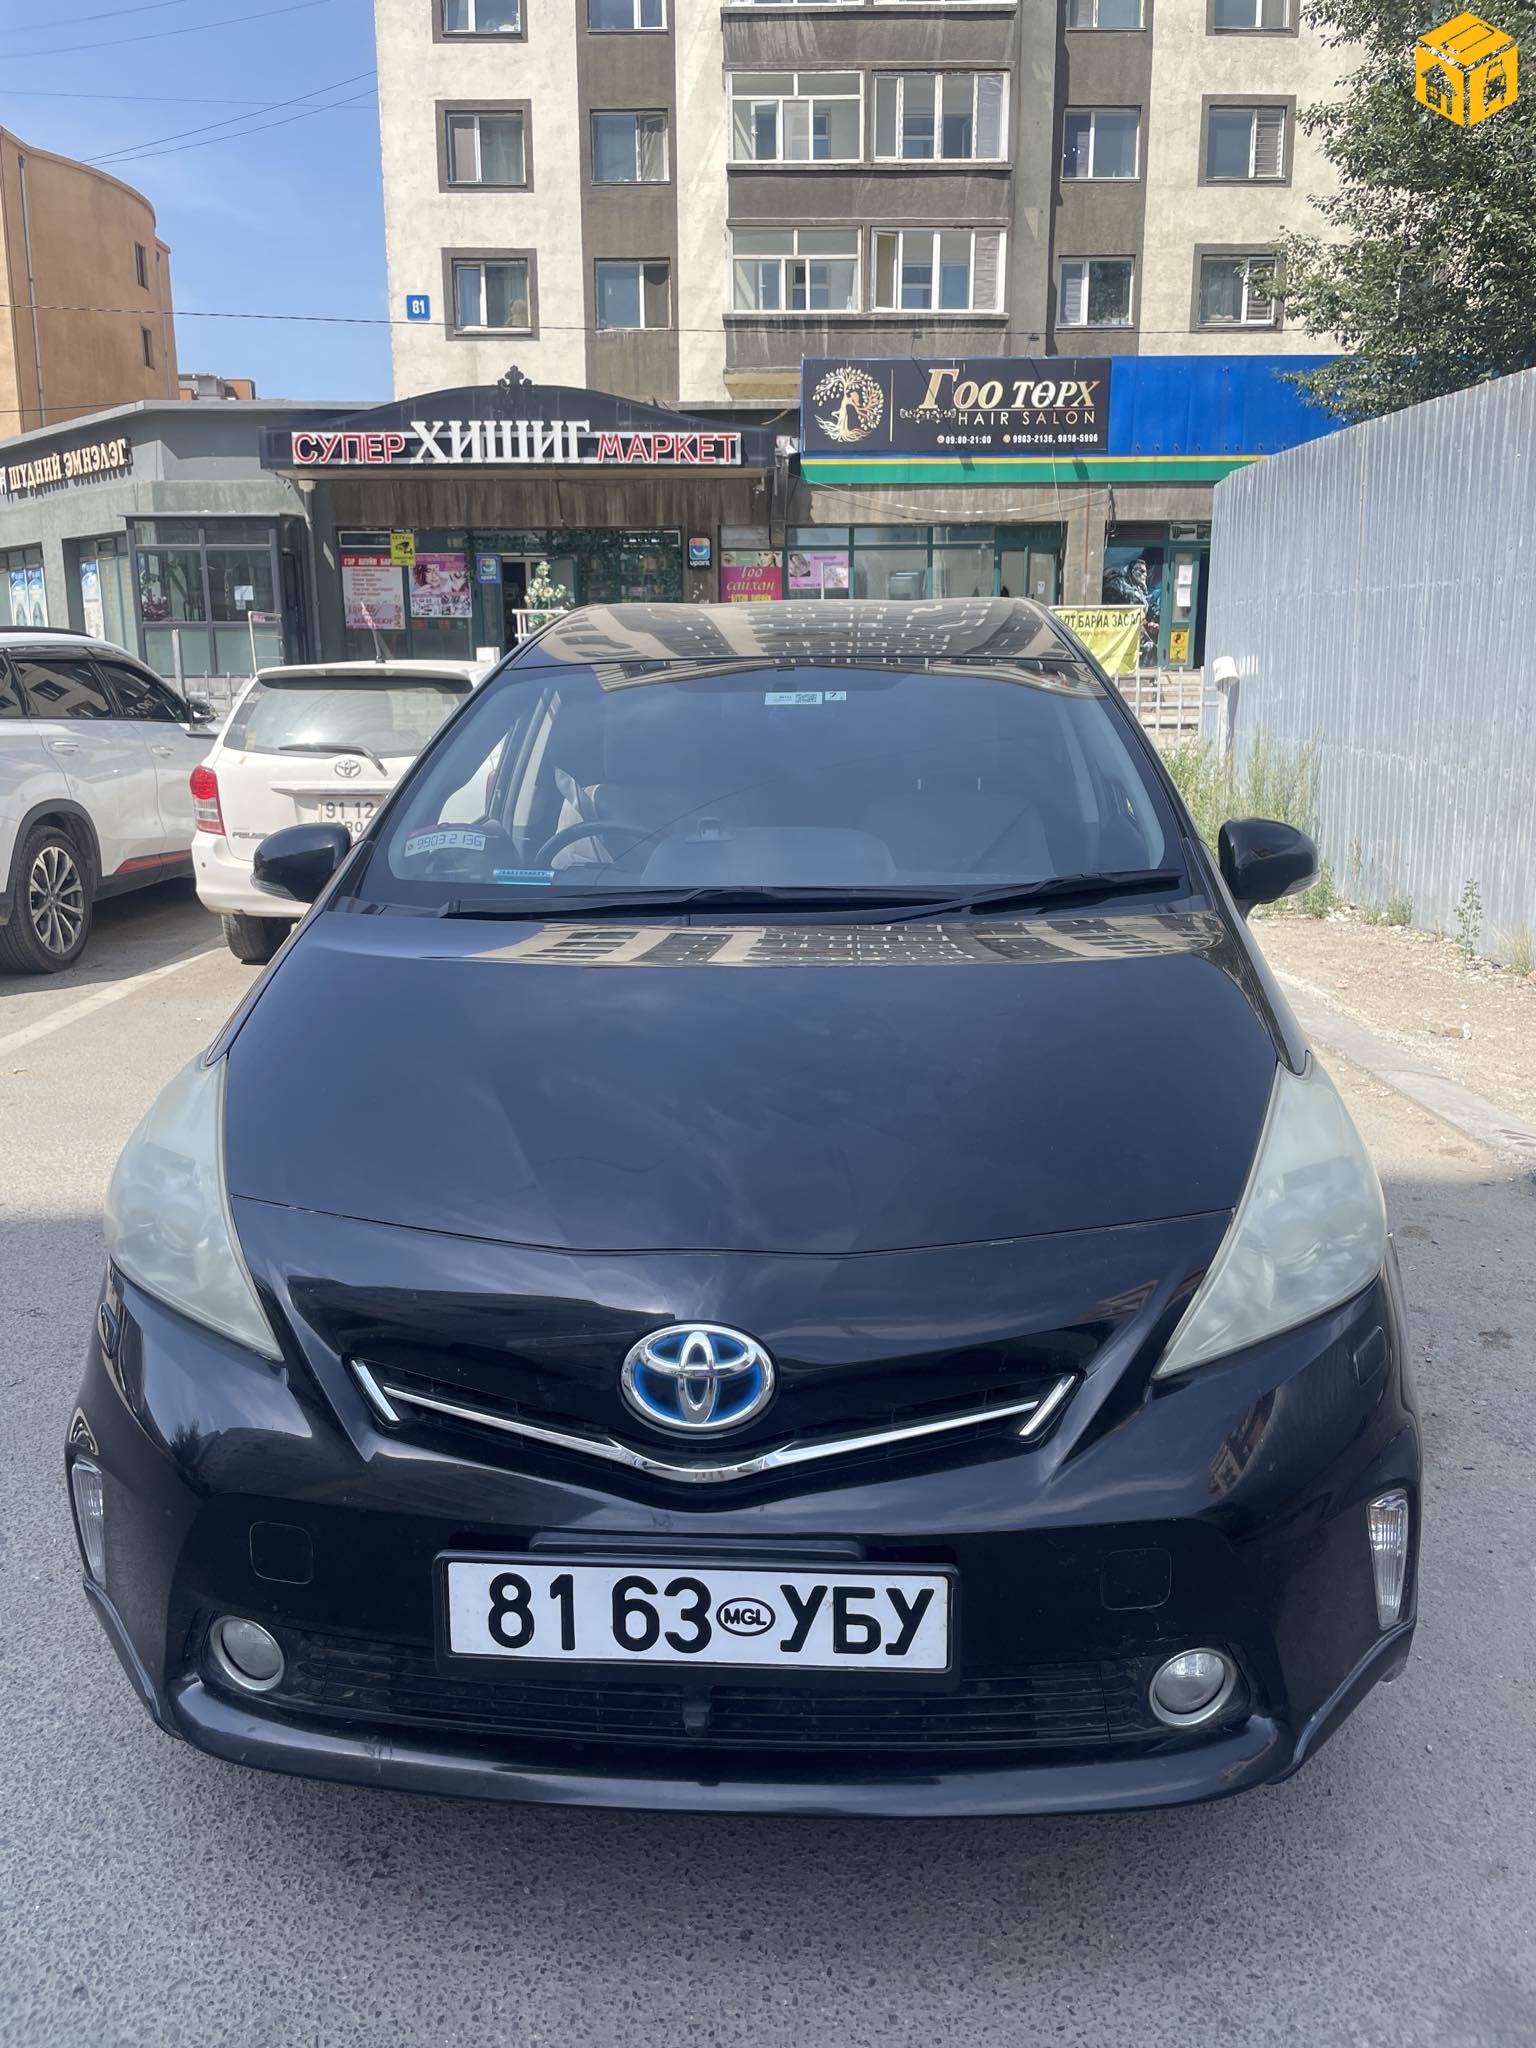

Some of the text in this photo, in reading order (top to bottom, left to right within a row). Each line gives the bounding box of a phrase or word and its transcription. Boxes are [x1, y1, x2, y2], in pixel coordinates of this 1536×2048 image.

[412, 299, 425, 314] 81
[958, 410, 1095, 426] HAIR SALON
[294, 419, 739, 465] СУПЕР ХИШИГ МАРКЕТ
[945, 435, 992, 445] 09:00-21:00
[63, 438, 129, 478] ЭМНЭЛЭГ
[1078, 613, 1109, 628] БАРИА
[326, 801, 345, 819] 91
[488, 1571, 935, 1656] 81 63 MGL УБУ
